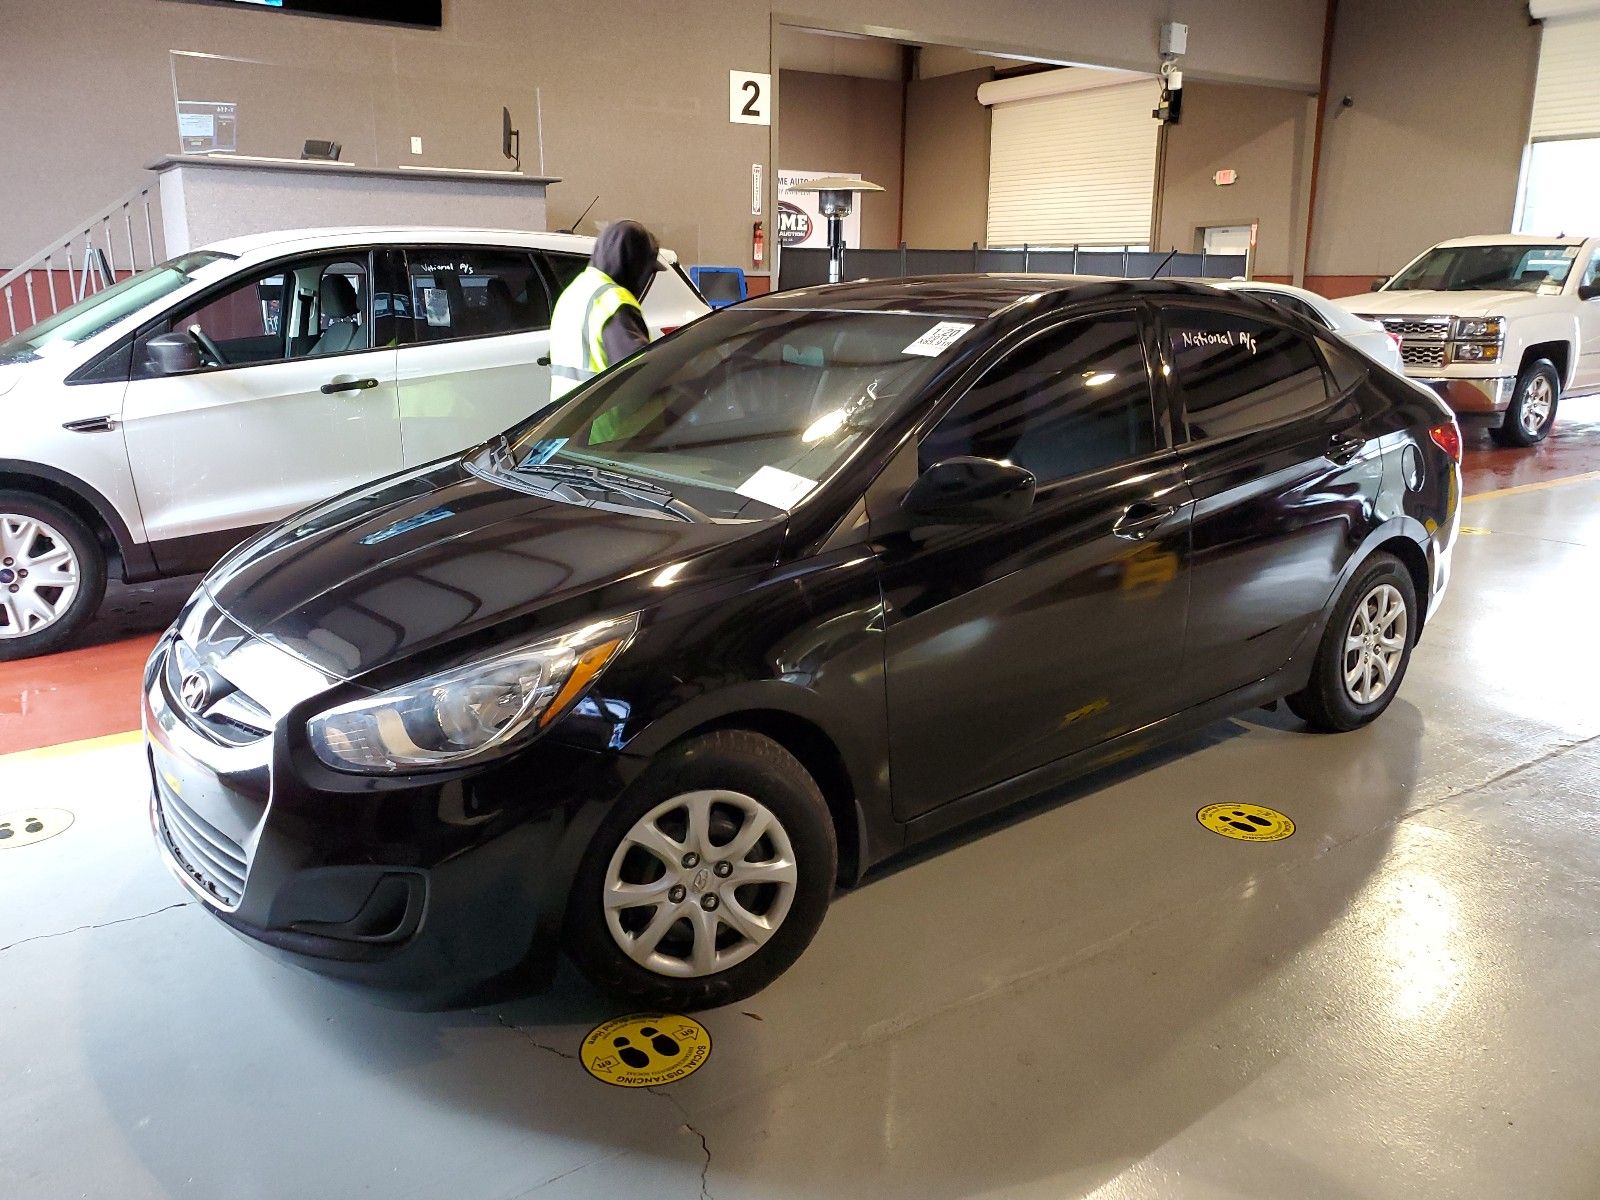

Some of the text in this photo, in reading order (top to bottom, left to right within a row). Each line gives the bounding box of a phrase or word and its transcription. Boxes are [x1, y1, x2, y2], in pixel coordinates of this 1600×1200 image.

[741, 80, 760, 117] 2
[1182, 331, 1234, 347] National
[683, 1045, 706, 1069] SOCIAL
[616, 1068, 685, 1084] DISTANCING
